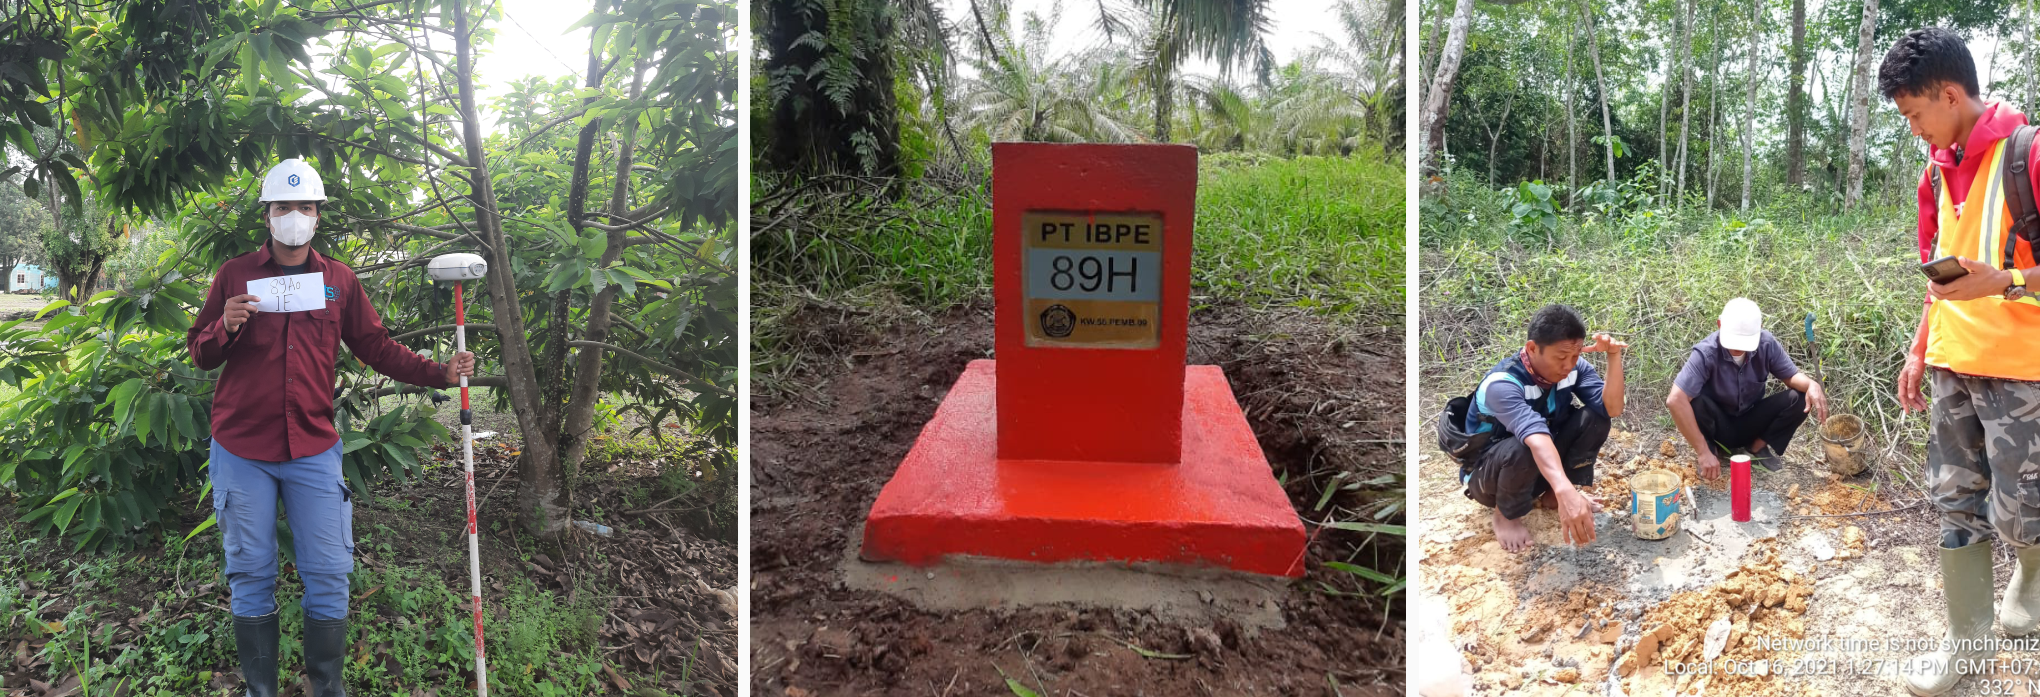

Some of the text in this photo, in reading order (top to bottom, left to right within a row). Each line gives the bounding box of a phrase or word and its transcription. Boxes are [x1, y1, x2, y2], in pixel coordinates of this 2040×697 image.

[1041, 222, 1150, 244] PT IBPE
[1050, 255, 1137, 292] 89H
